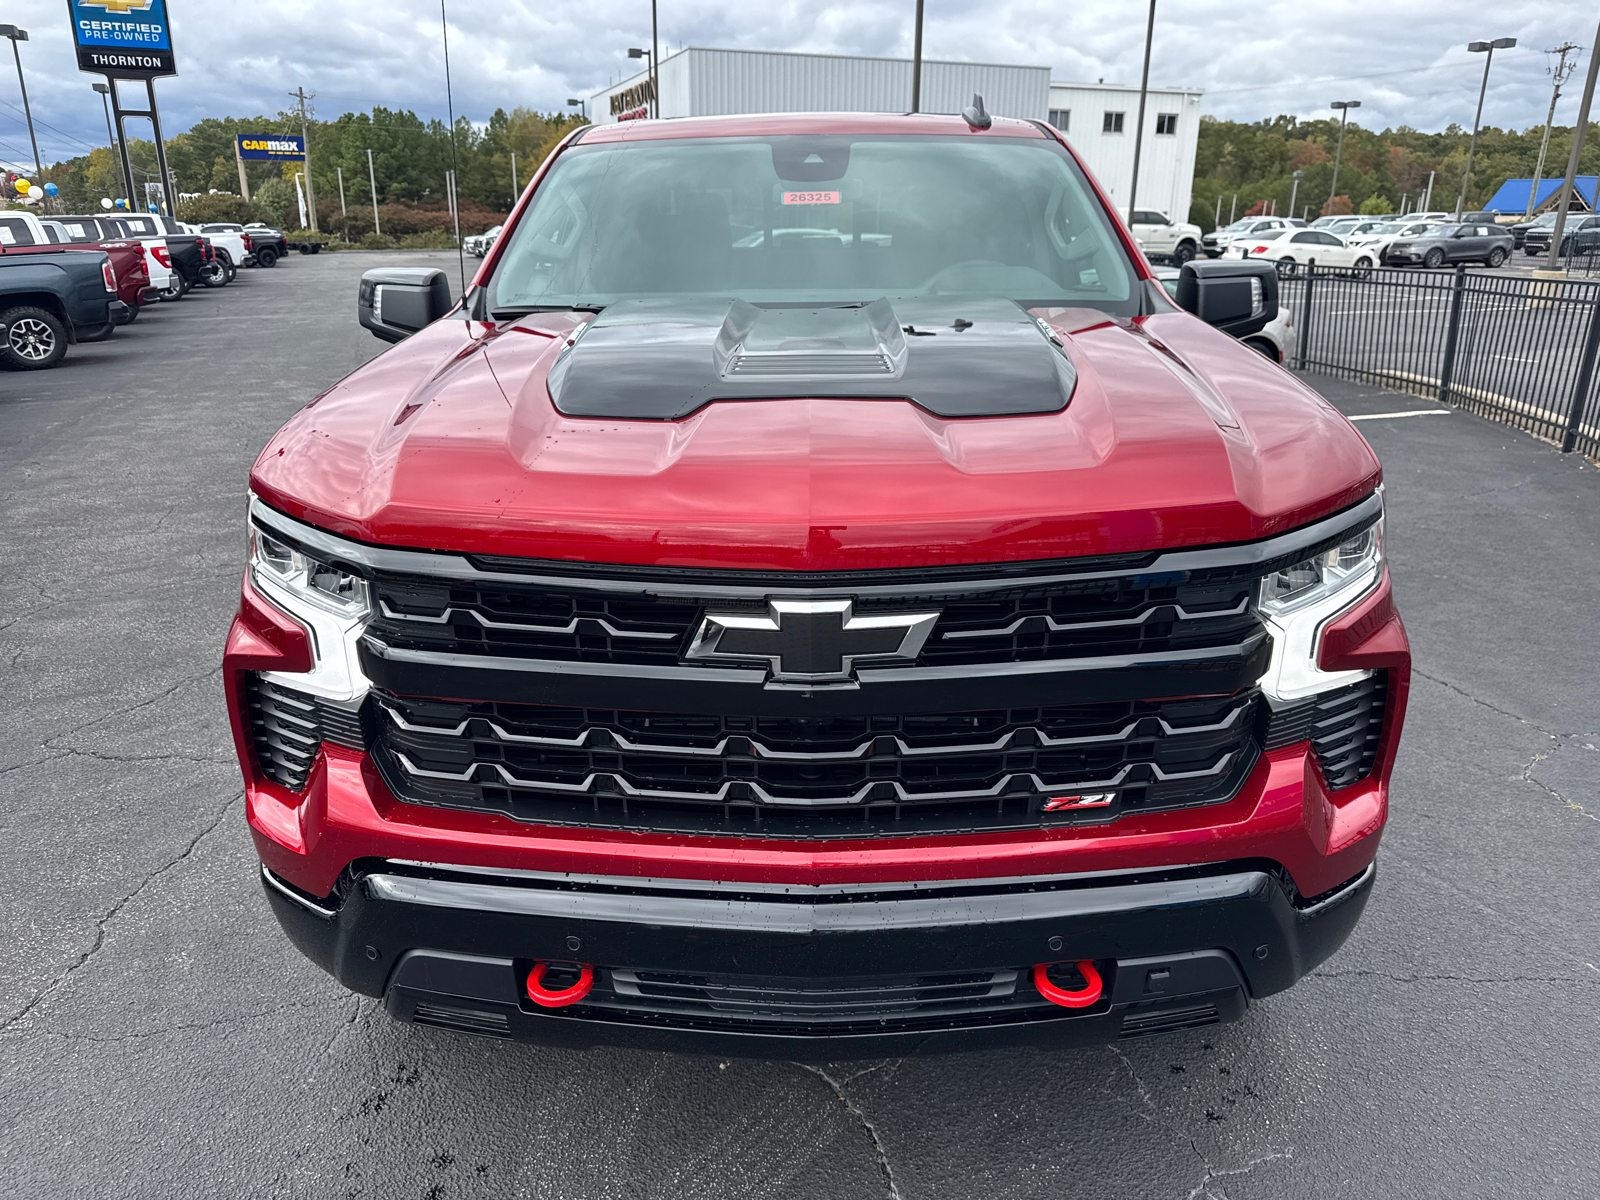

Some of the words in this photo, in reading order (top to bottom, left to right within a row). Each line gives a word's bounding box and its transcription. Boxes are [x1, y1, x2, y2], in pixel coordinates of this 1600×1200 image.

[79, 20, 162, 33] CERTIFIED
[85, 30, 160, 42] PRE-OWNED
[91, 54, 162, 67] THORNTON
[790, 193, 832, 202] 26325
